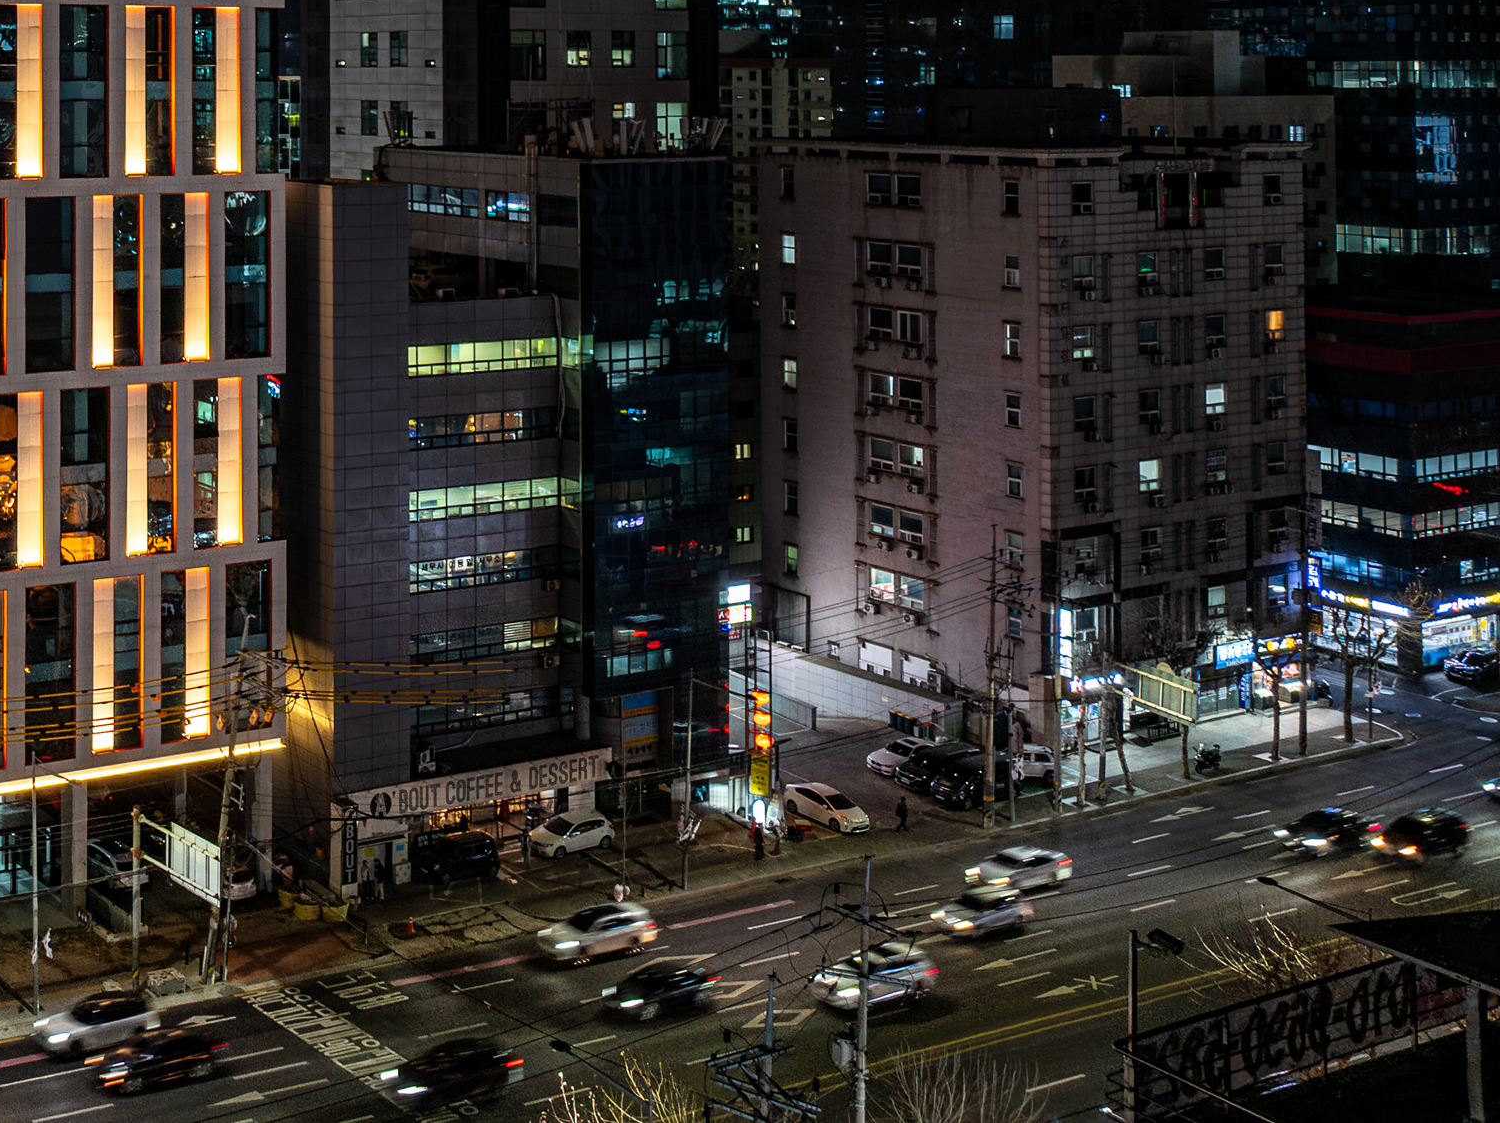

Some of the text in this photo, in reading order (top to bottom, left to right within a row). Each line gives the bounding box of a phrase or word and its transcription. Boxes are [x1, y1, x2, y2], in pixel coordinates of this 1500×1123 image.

[445, 772, 503, 806] COFFEE
[509, 769, 522, 793] &
[528, 754, 599, 791] DESSERT
[316, 970, 411, 1011] 여의도
